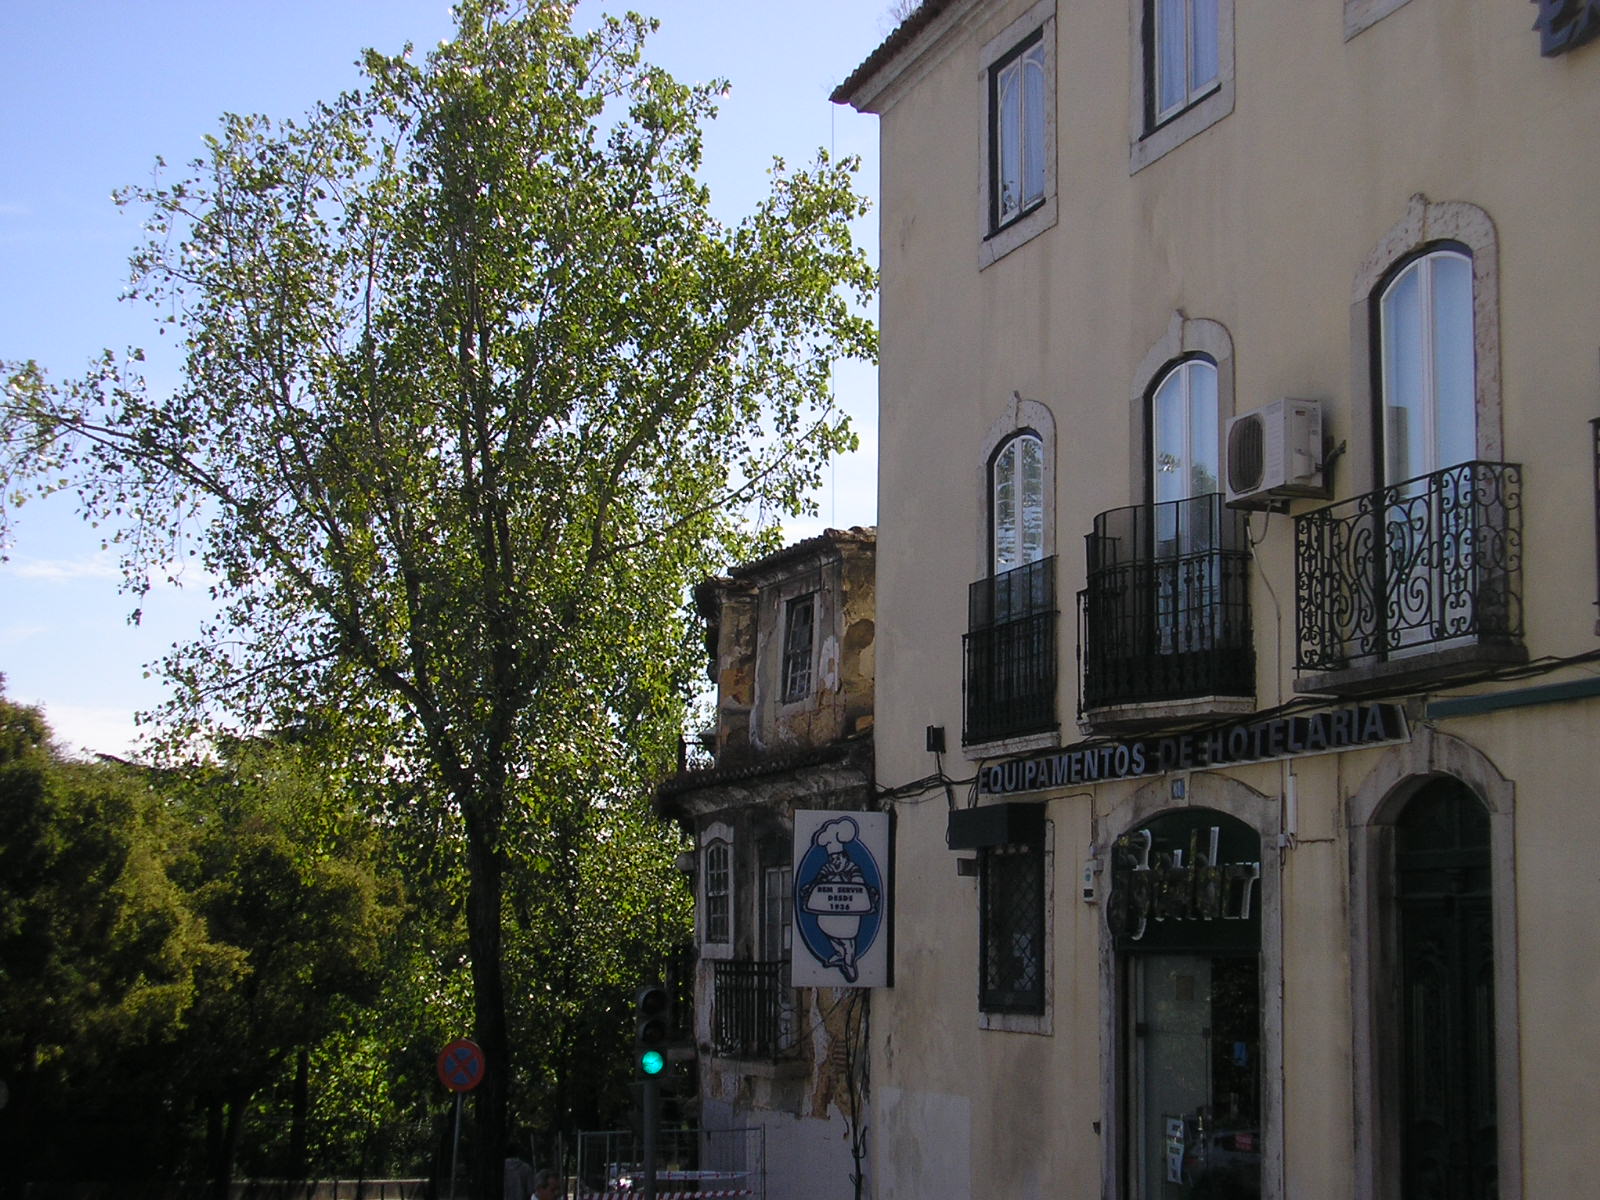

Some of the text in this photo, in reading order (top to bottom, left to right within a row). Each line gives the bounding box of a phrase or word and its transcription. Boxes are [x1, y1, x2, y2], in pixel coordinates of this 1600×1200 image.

[977, 703, 1386, 795] EQUIPAMENTOS DE HOTELARIA
